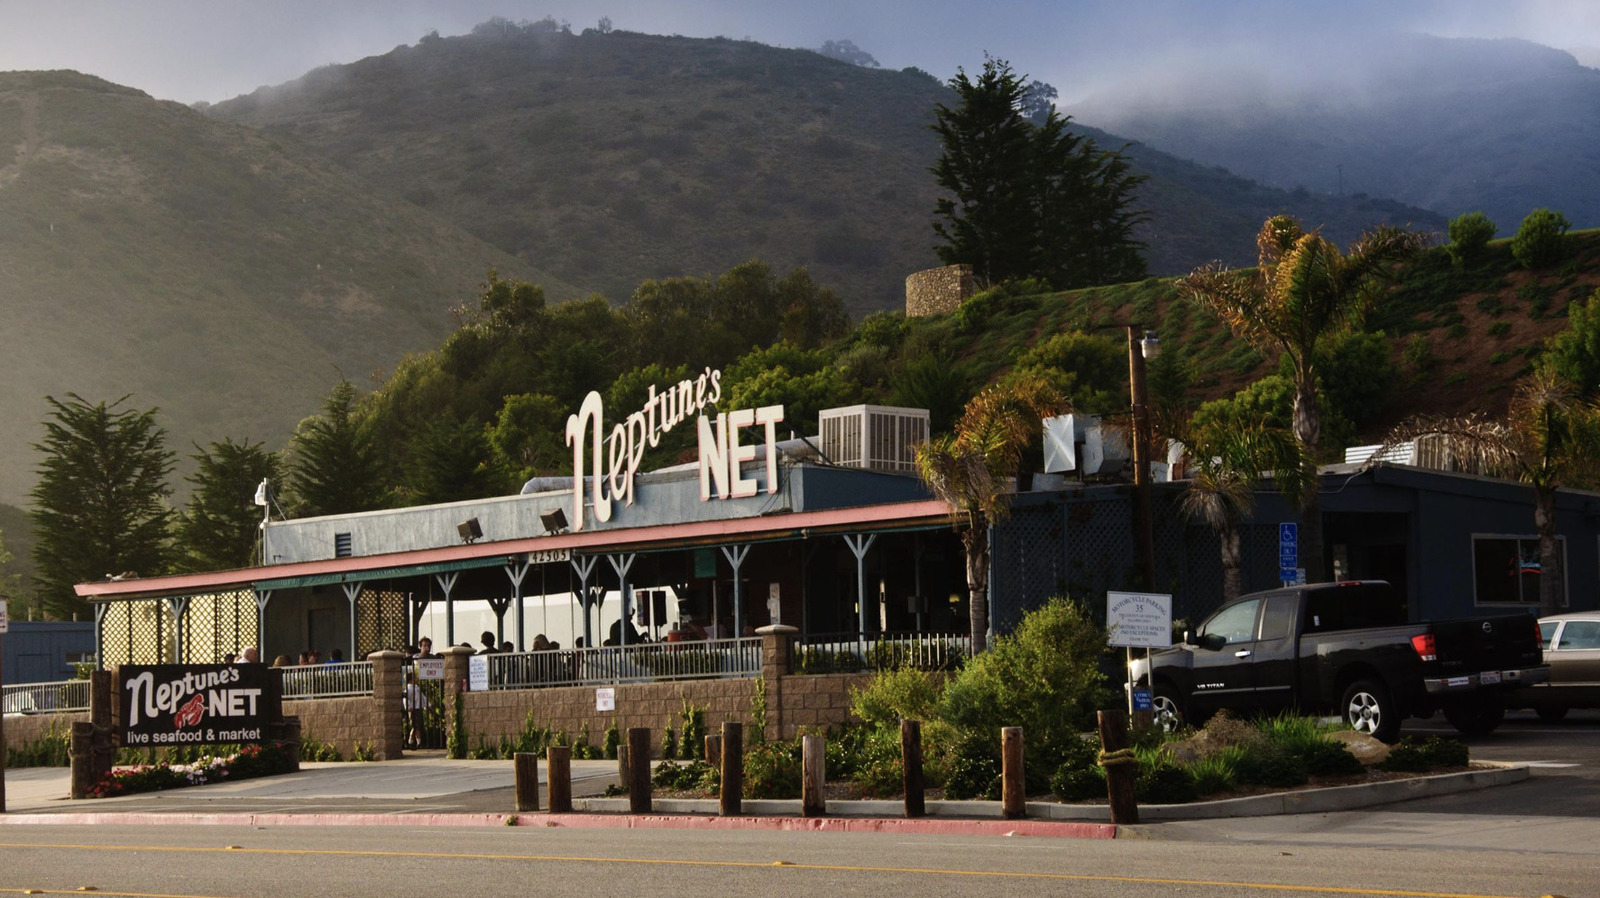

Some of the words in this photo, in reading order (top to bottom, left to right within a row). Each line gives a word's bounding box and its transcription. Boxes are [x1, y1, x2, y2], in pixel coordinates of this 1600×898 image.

[566, 366, 721, 532] Neptune's
[697, 404, 784, 501] NET
[532, 549, 567, 563] 42505
[1112, 596, 1146, 613] MOTORCYCLE
[1146, 598, 1168, 616] PARKING
[1135, 604, 1144, 613] 35
[126, 667, 240, 727] Neptune's
[209, 688, 261, 717] NET
[127, 731, 149, 744] live
[152, 729, 203, 743] seafood
[206, 729, 216, 741] &
[219, 728, 261, 741] market
